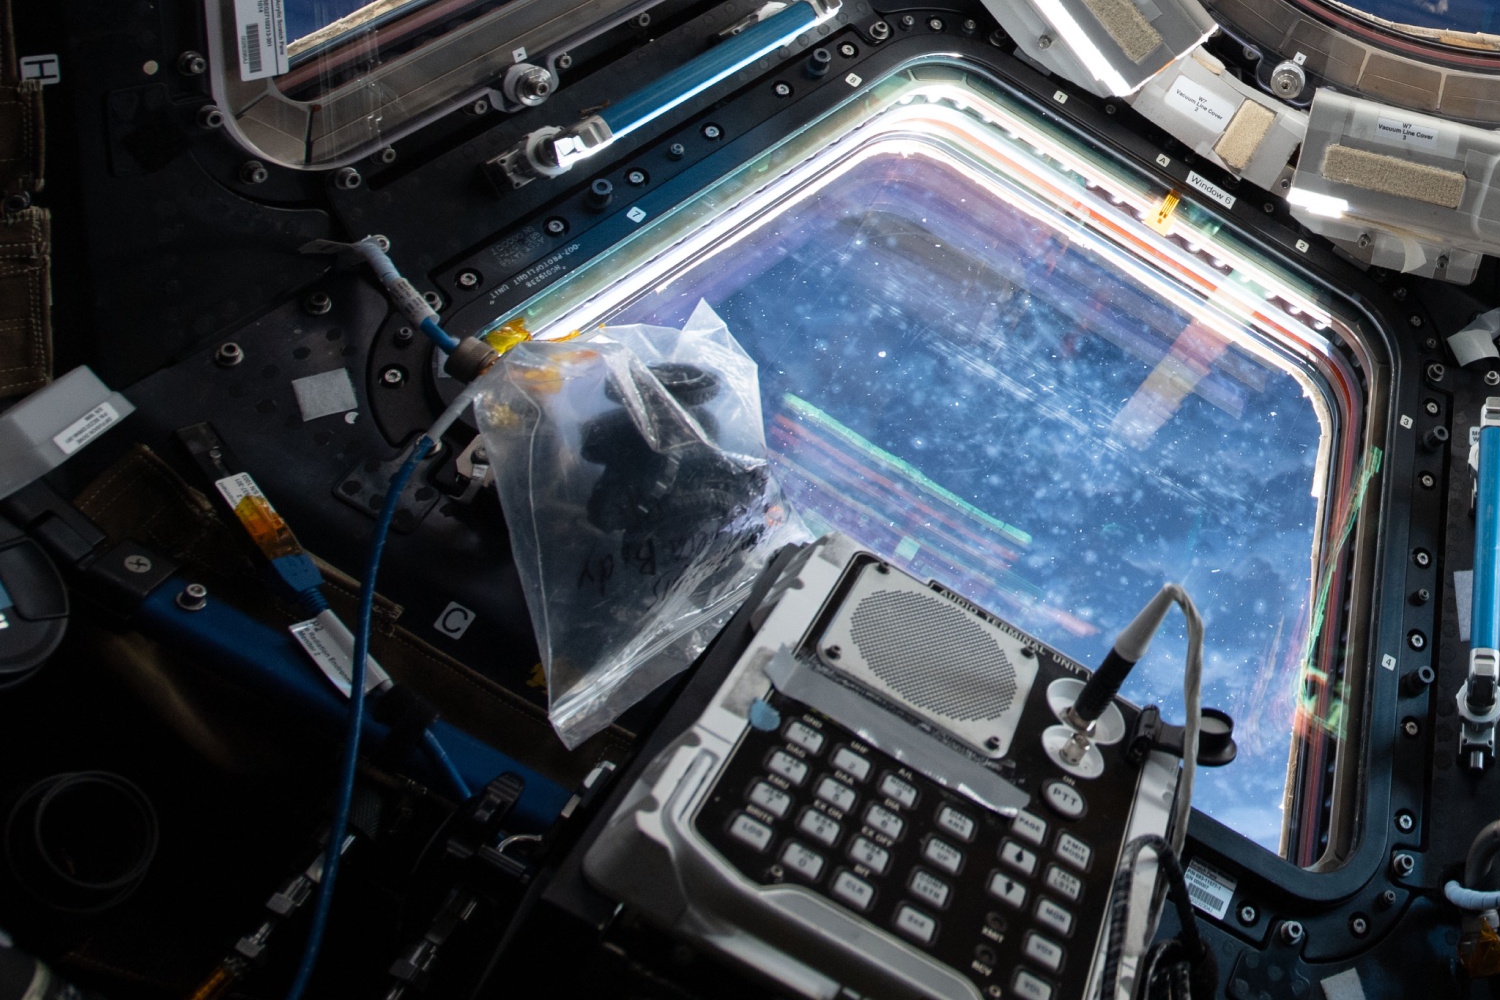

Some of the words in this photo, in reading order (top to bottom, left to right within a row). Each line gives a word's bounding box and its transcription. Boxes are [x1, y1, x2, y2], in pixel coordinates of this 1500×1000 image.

[274, 0, 282, 18] Acrylic
[22, 58, 58, 82] H
[1175, 88, 1197, 104] Vacuum
[1195, 101, 1208, 111] Line
[1207, 108, 1223, 120] Cover
[1197, 95, 1207, 104] W7
[1377, 123, 1401, 133] Vacuum
[1402, 128, 1415, 136] Line
[1415, 131, 1433, 140] Cover
[1189, 174, 1225, 200] Window
[1223, 196, 1232, 205] 6
[440, 605, 469, 635] C
[938, 588, 985, 620] AUDIO
[986, 613, 1047, 656] TERMINAL
[1050, 654, 1082, 675] UNIT
[307, 630, 331, 658] Radiation
[898, 768, 914, 781] A/L
[1062, 776, 1076, 786] ON
[1052, 787, 1077, 806] PTT
[1018, 816, 1041, 833] PAGE
[1062, 846, 1086, 863] MODE
[1066, 839, 1087, 855] XMIT
[1046, 907, 1066, 923] MON
